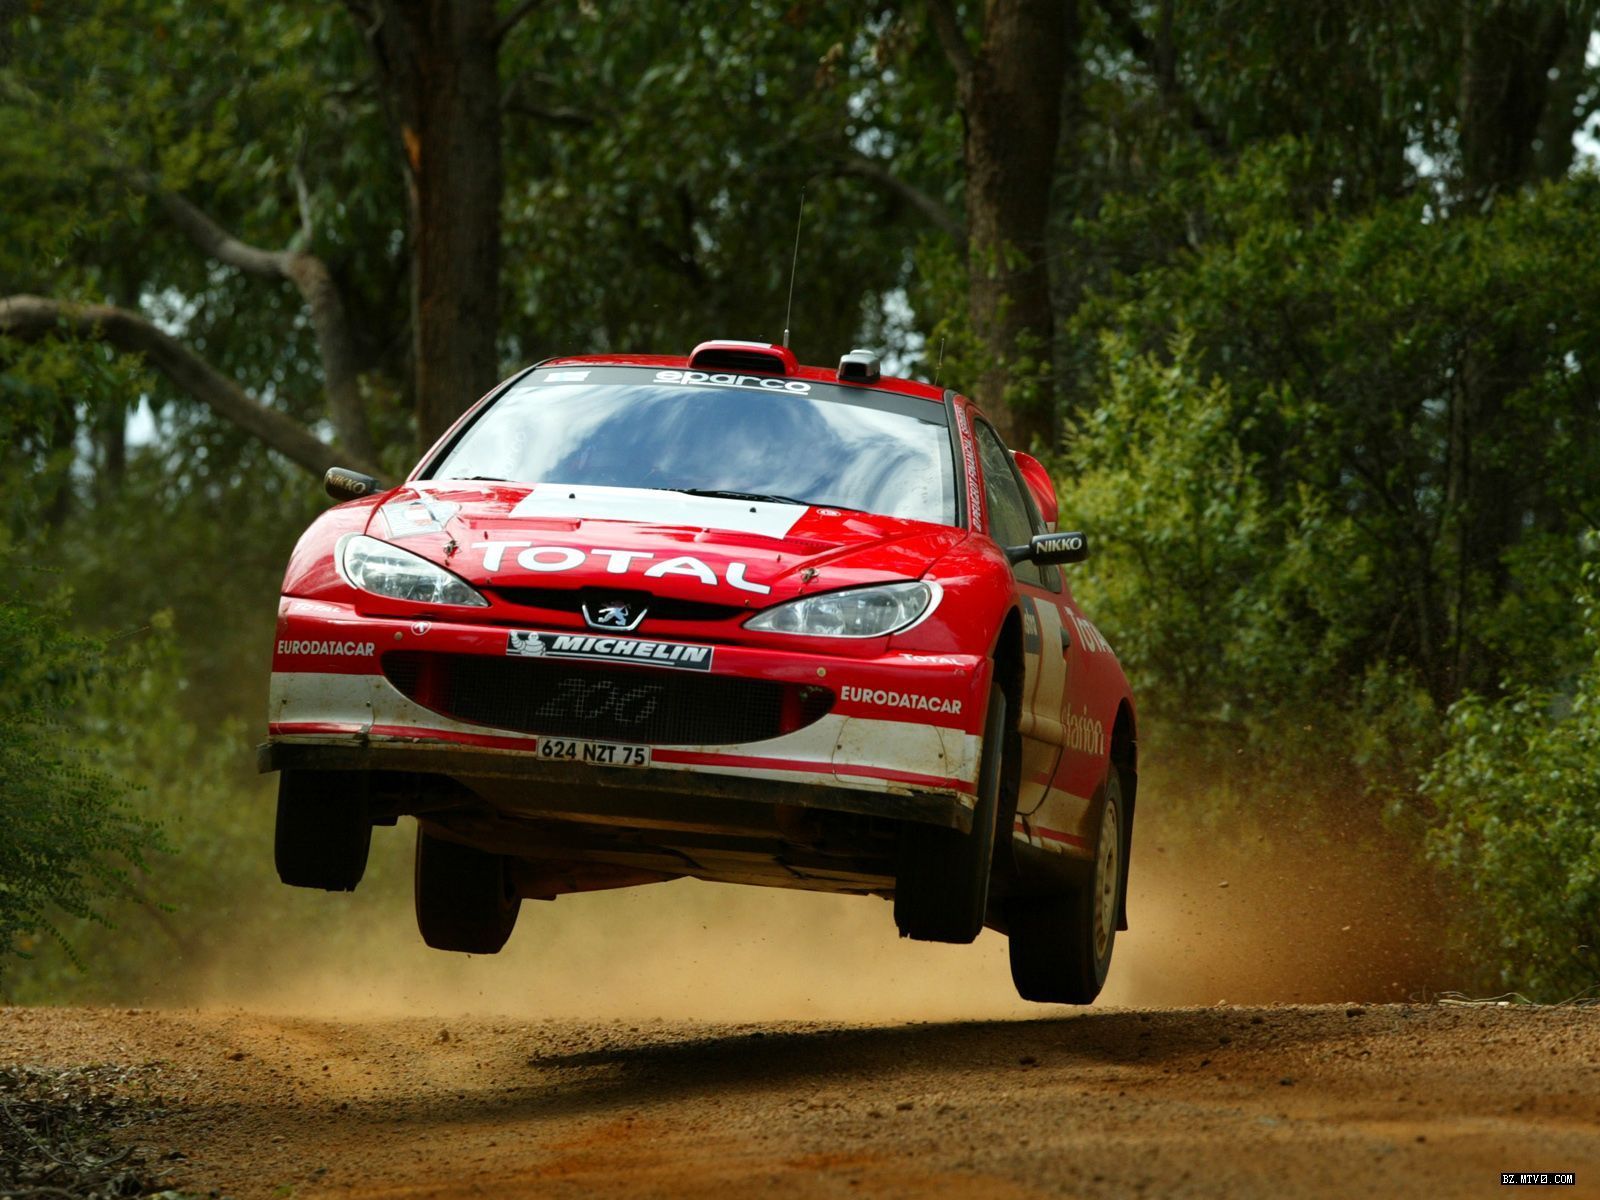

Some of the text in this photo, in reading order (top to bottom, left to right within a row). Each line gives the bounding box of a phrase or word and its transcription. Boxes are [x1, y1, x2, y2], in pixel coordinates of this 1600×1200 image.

[653, 370, 812, 394] sparco
[325, 474, 366, 494] NIKKO
[1036, 537, 1083, 555] NIKKO
[470, 540, 771, 595] TOTAL
[293, 602, 342, 614] TOTAL
[277, 640, 375, 656] EURODATACAR
[551, 635, 707, 663] MICHELIN
[898, 653, 967, 667] TOTAL
[840, 685, 962, 714] EURODATACAR
[542, 740, 646, 765] 624 NZT 75
